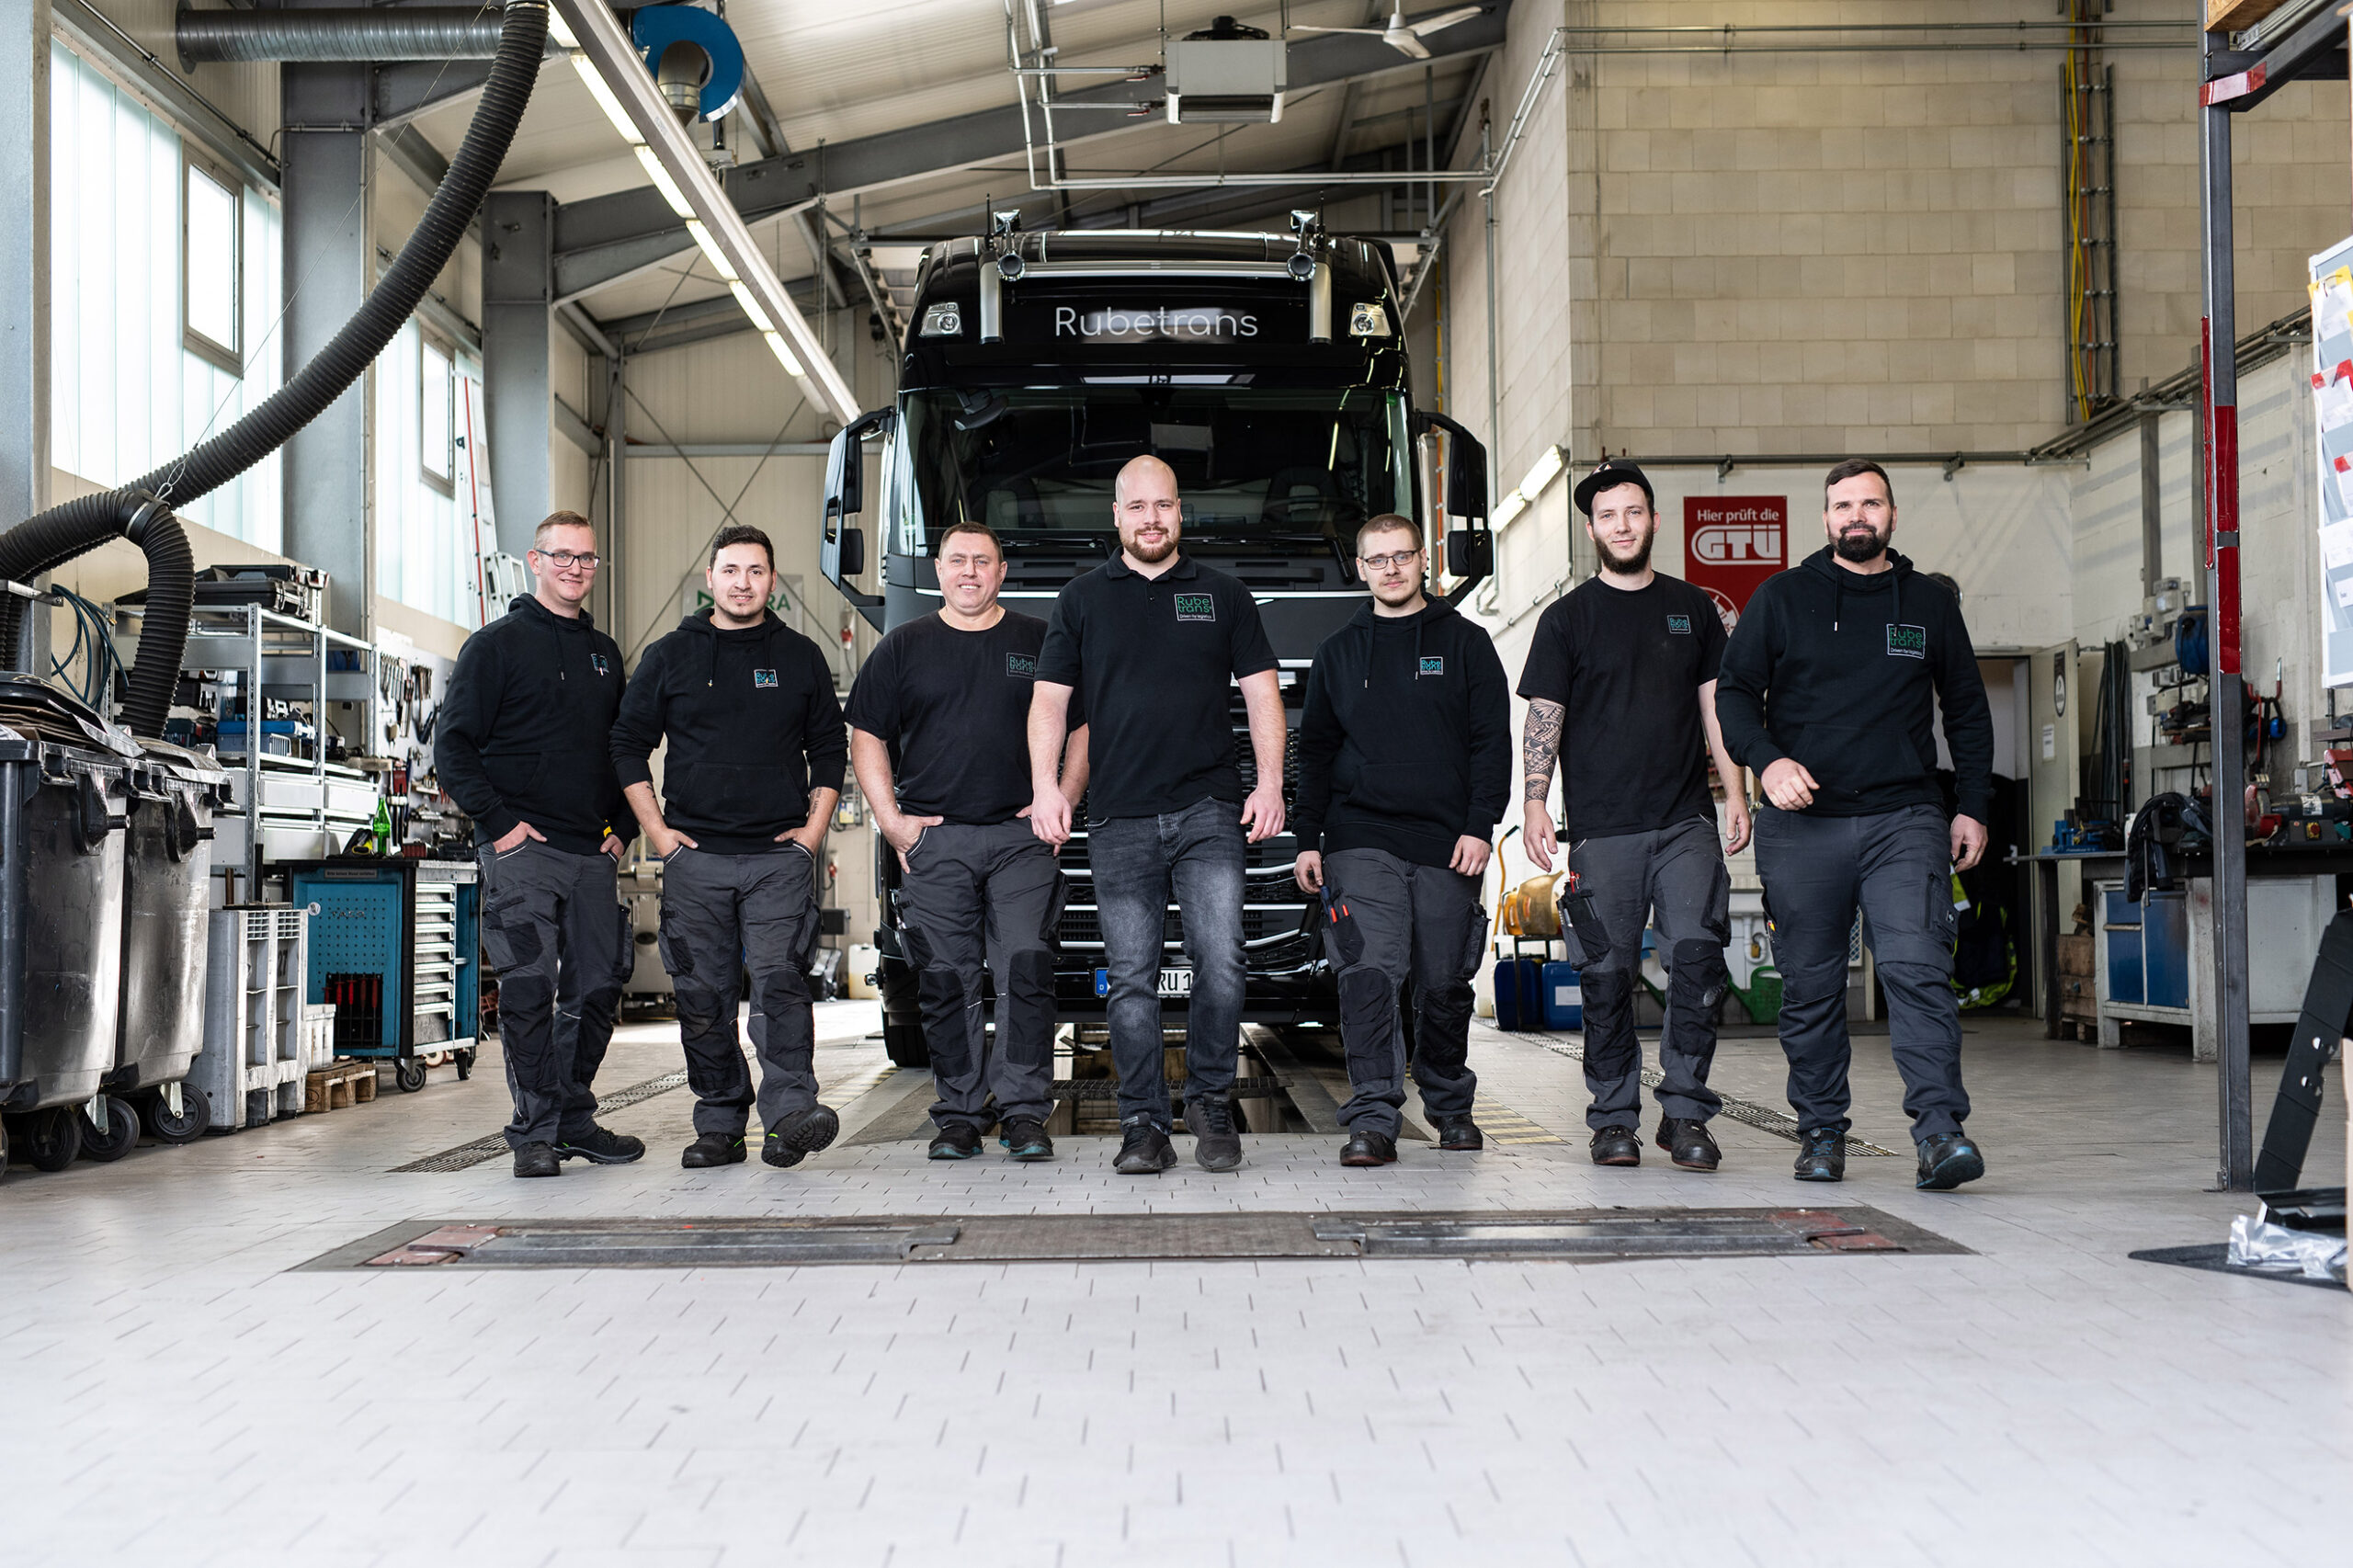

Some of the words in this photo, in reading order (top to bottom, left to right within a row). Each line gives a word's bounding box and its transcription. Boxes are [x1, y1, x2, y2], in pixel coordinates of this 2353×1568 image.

[1055, 306, 1258, 336] Rubetrans
[1697, 508, 1723, 521] Hier
[1726, 508, 1757, 524] prüft
[1760, 507, 1779, 521] die
[1691, 525, 1781, 565] GTÜ
[1176, 596, 1210, 606] Rube
